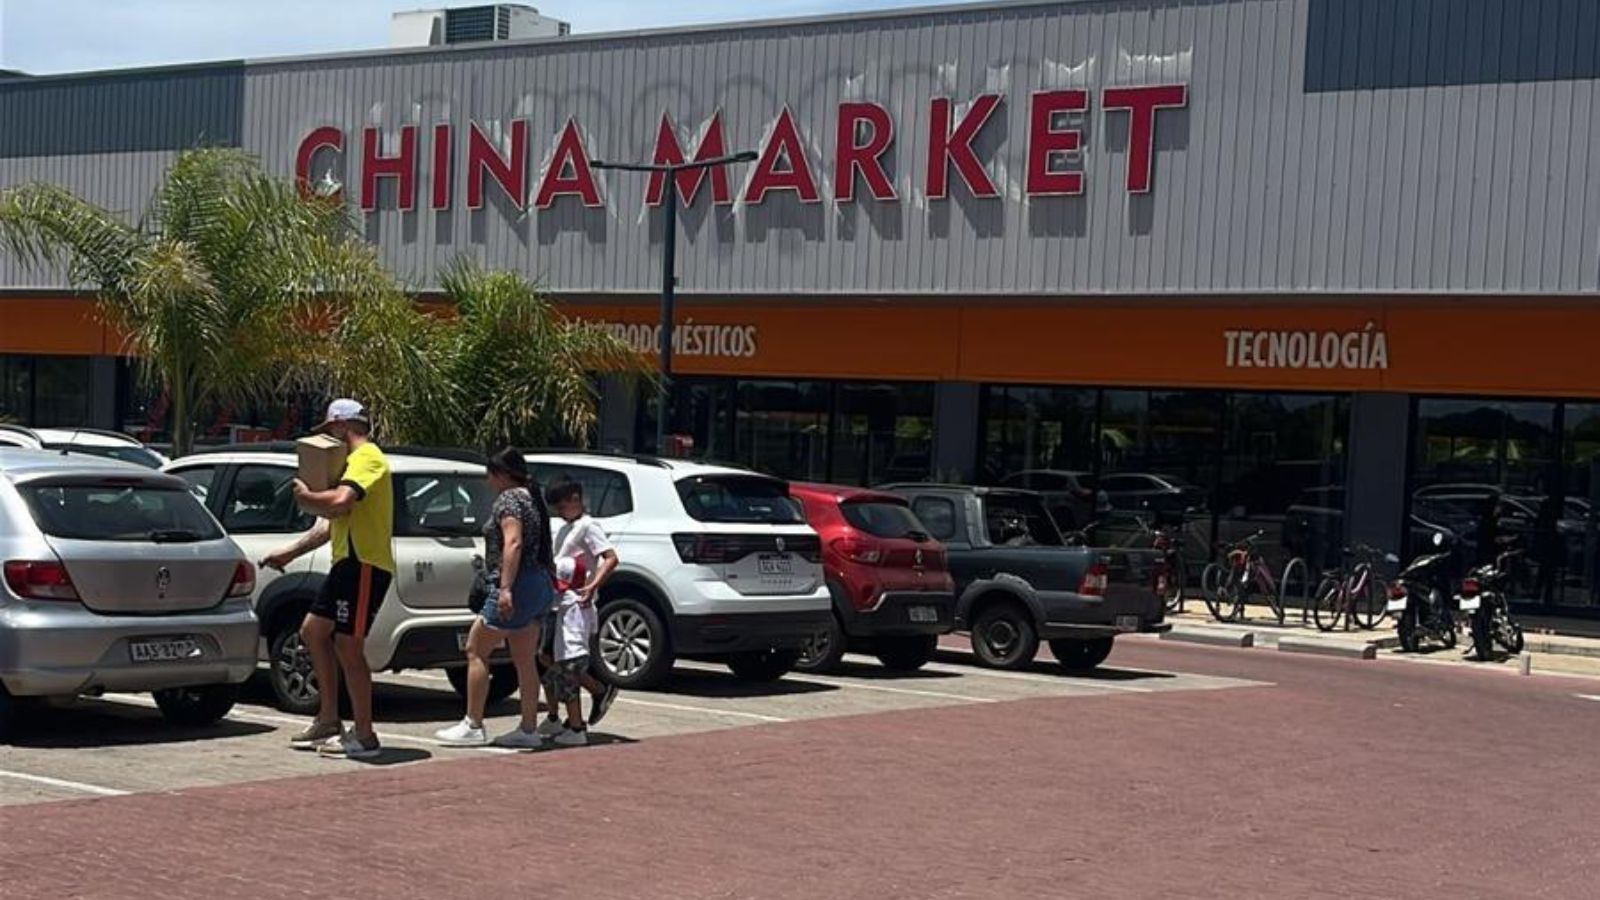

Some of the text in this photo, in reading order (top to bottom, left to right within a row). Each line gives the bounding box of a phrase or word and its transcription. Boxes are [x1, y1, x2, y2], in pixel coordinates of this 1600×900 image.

[295, 84, 1188, 211] CHINA MARKET
[1224, 321, 1388, 369] TECNOLOGÍA
